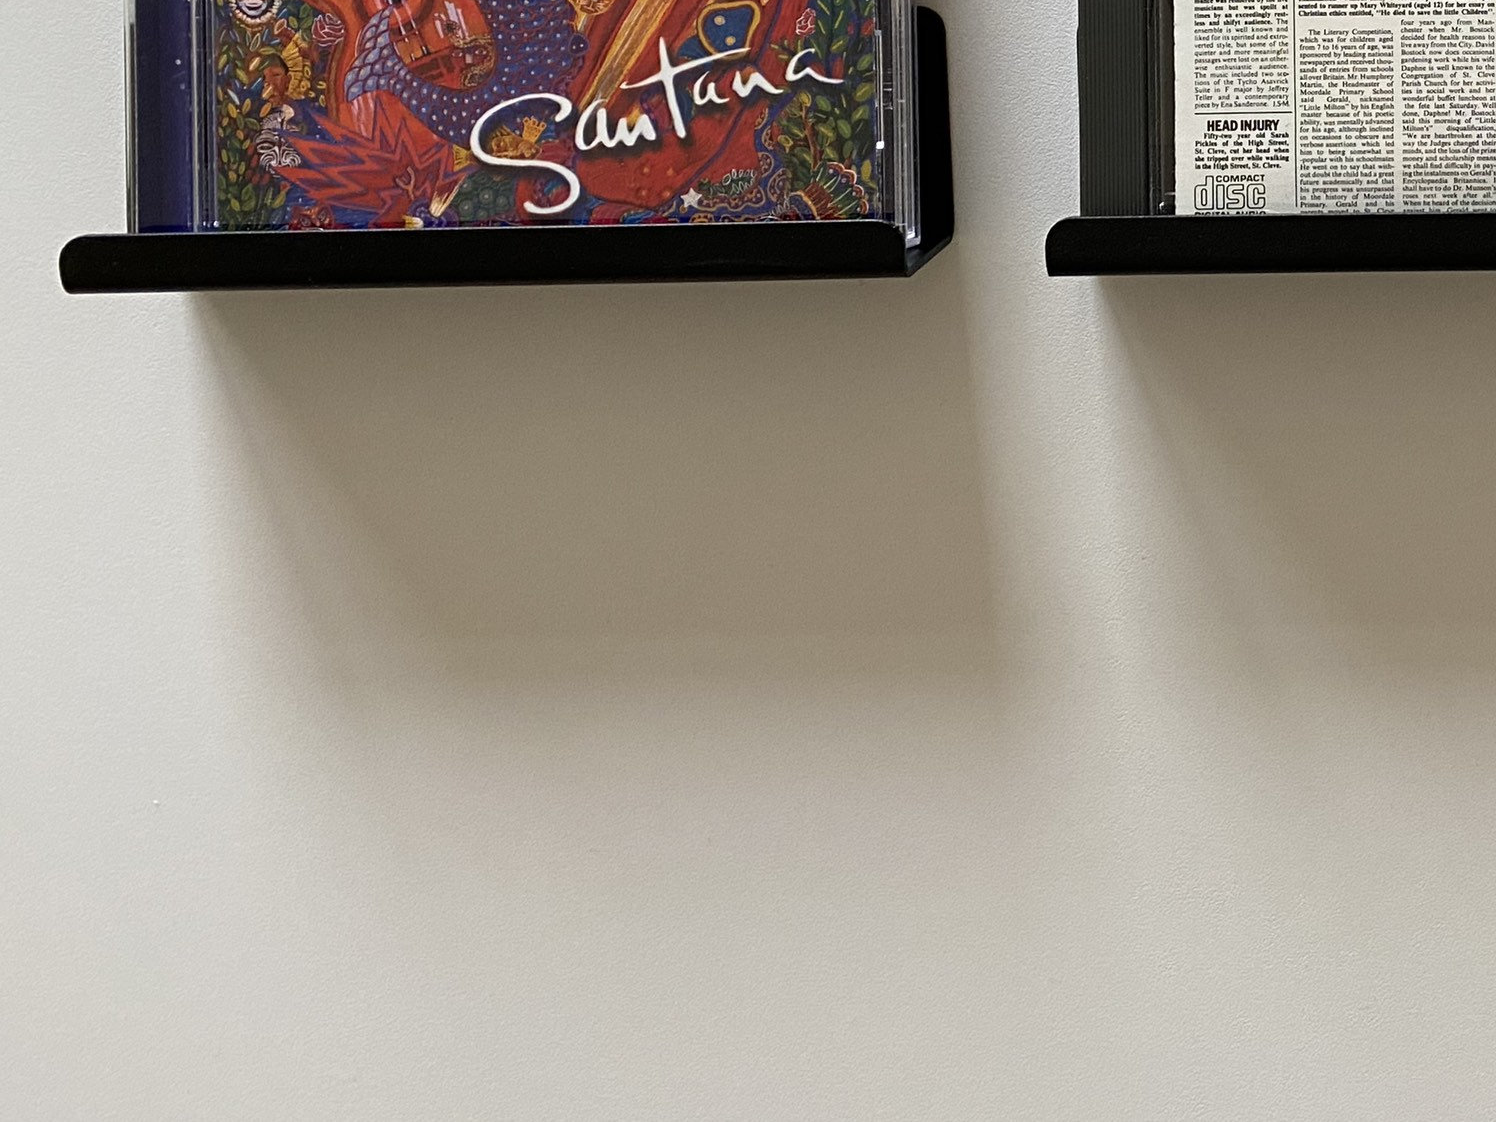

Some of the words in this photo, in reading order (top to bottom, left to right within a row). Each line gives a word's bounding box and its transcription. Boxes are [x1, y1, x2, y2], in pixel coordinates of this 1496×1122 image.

[470, 38, 844, 215] Santana
[1207, 120, 1238, 131] HEAD
[1241, 120, 1279, 131] INJURY
